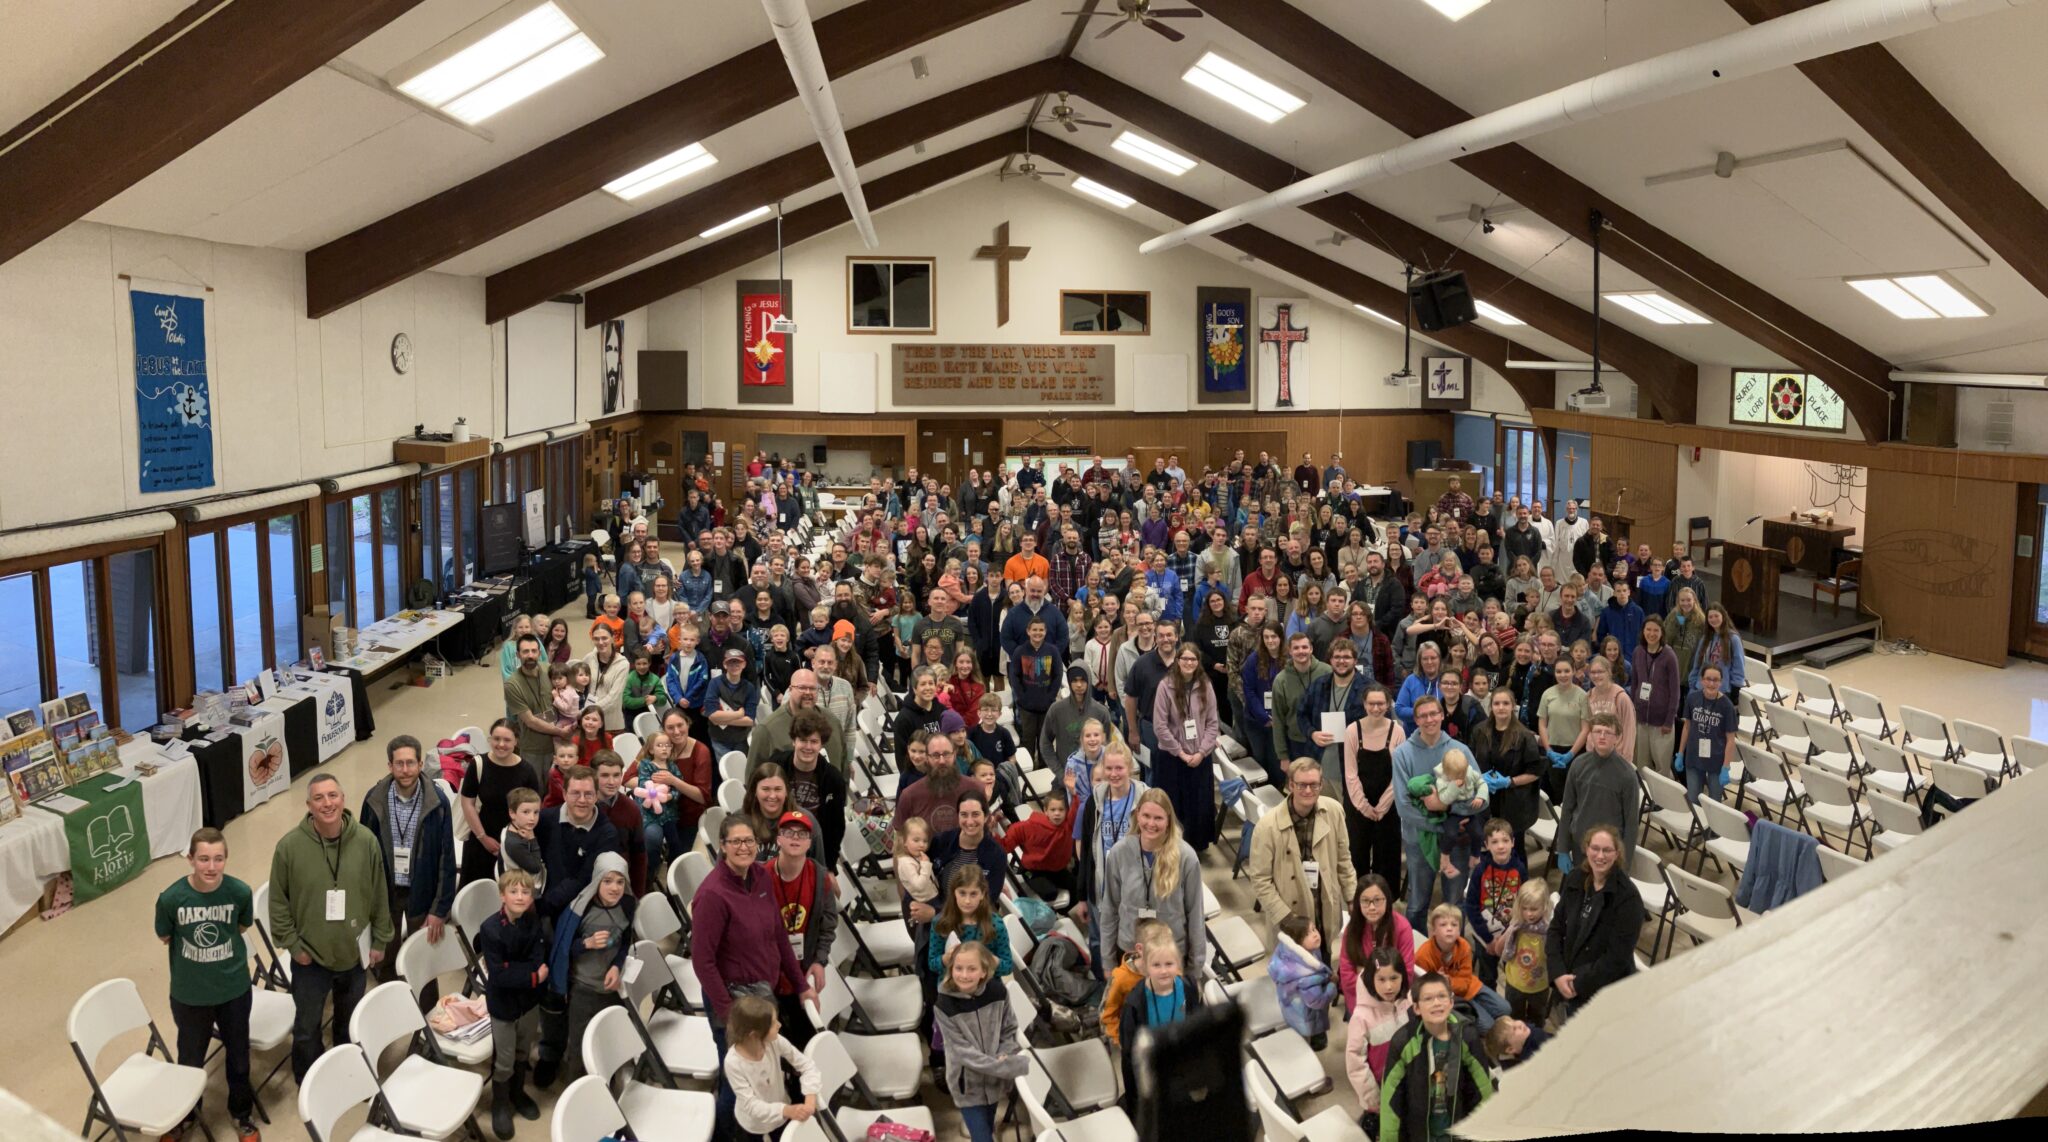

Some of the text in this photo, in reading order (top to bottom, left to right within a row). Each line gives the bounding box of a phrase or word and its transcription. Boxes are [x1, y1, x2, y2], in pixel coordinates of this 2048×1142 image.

[759, 300, 779, 308] JESUS
[1217, 309, 1235, 317] GOD'S
[744, 306, 752, 342] TEACHING
[940, 346, 956, 358] IS
[960, 346, 986, 358] THE
[991, 346, 1016, 358] DAY
[1022, 346, 1065, 358] WHICH
[1070, 346, 1097, 358] THE
[137, 353, 171, 376] JESUS
[171, 356, 179, 365] at
[171, 366, 181, 376] the
[903, 361, 937, 374] LORD
[1027, 361, 1047, 374] WE
[1053, 361, 1088, 374] WILL
[903, 376, 962, 389] REJOICE
[967, 376, 993, 389] AND
[998, 376, 1016, 389] BE
[1021, 376, 1056, 389] GLAD
[1063, 376, 1076, 389] IN
[1735, 374, 1758, 403] SURELY
[1040, 391, 1072, 401] PSALM
[1748, 396, 1765, 418] LORD
[1807, 395, 1829, 424] PLACE
[1693, 711, 1721, 727] CHAPTER
[177, 904, 235, 926] OAKMONT
